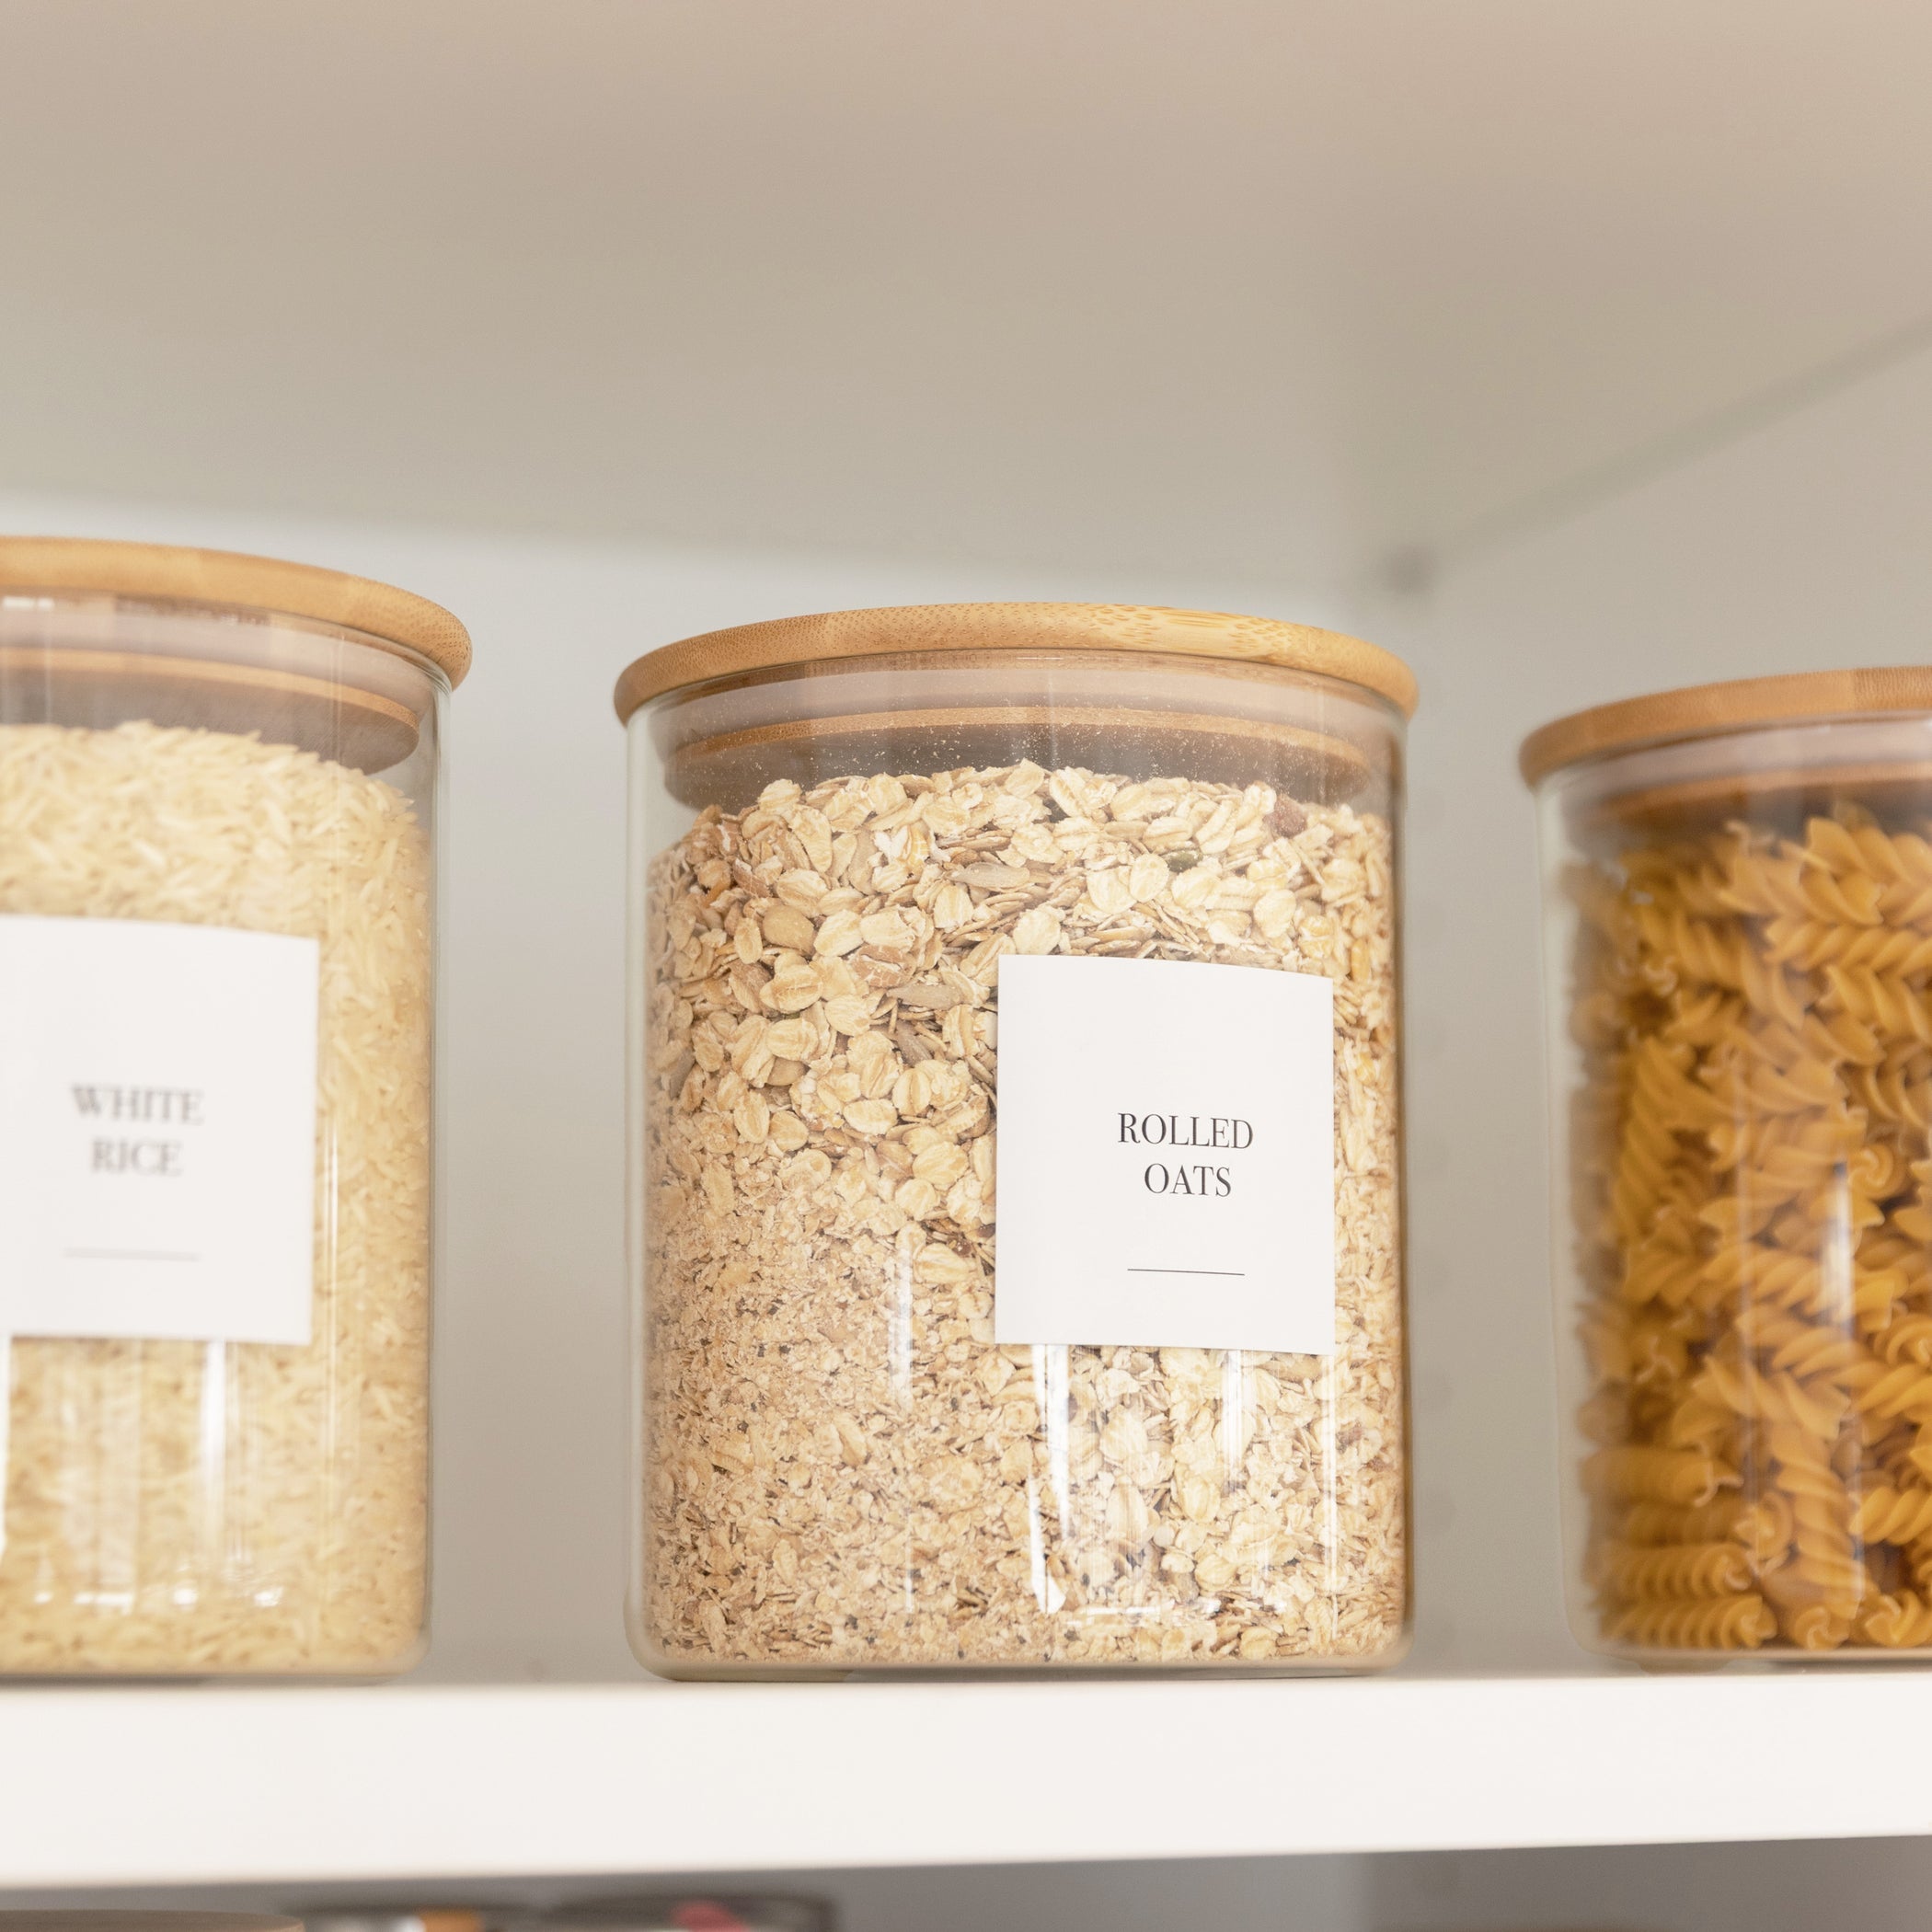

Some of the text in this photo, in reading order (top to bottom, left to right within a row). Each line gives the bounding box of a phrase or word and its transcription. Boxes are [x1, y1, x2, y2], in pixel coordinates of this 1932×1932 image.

[71, 1083, 204, 1125] WHITE
[1118, 1112, 1254, 1149] ROLLED
[91, 1138, 183, 1176] RICE
[1144, 1163, 1232, 1197] OATS
